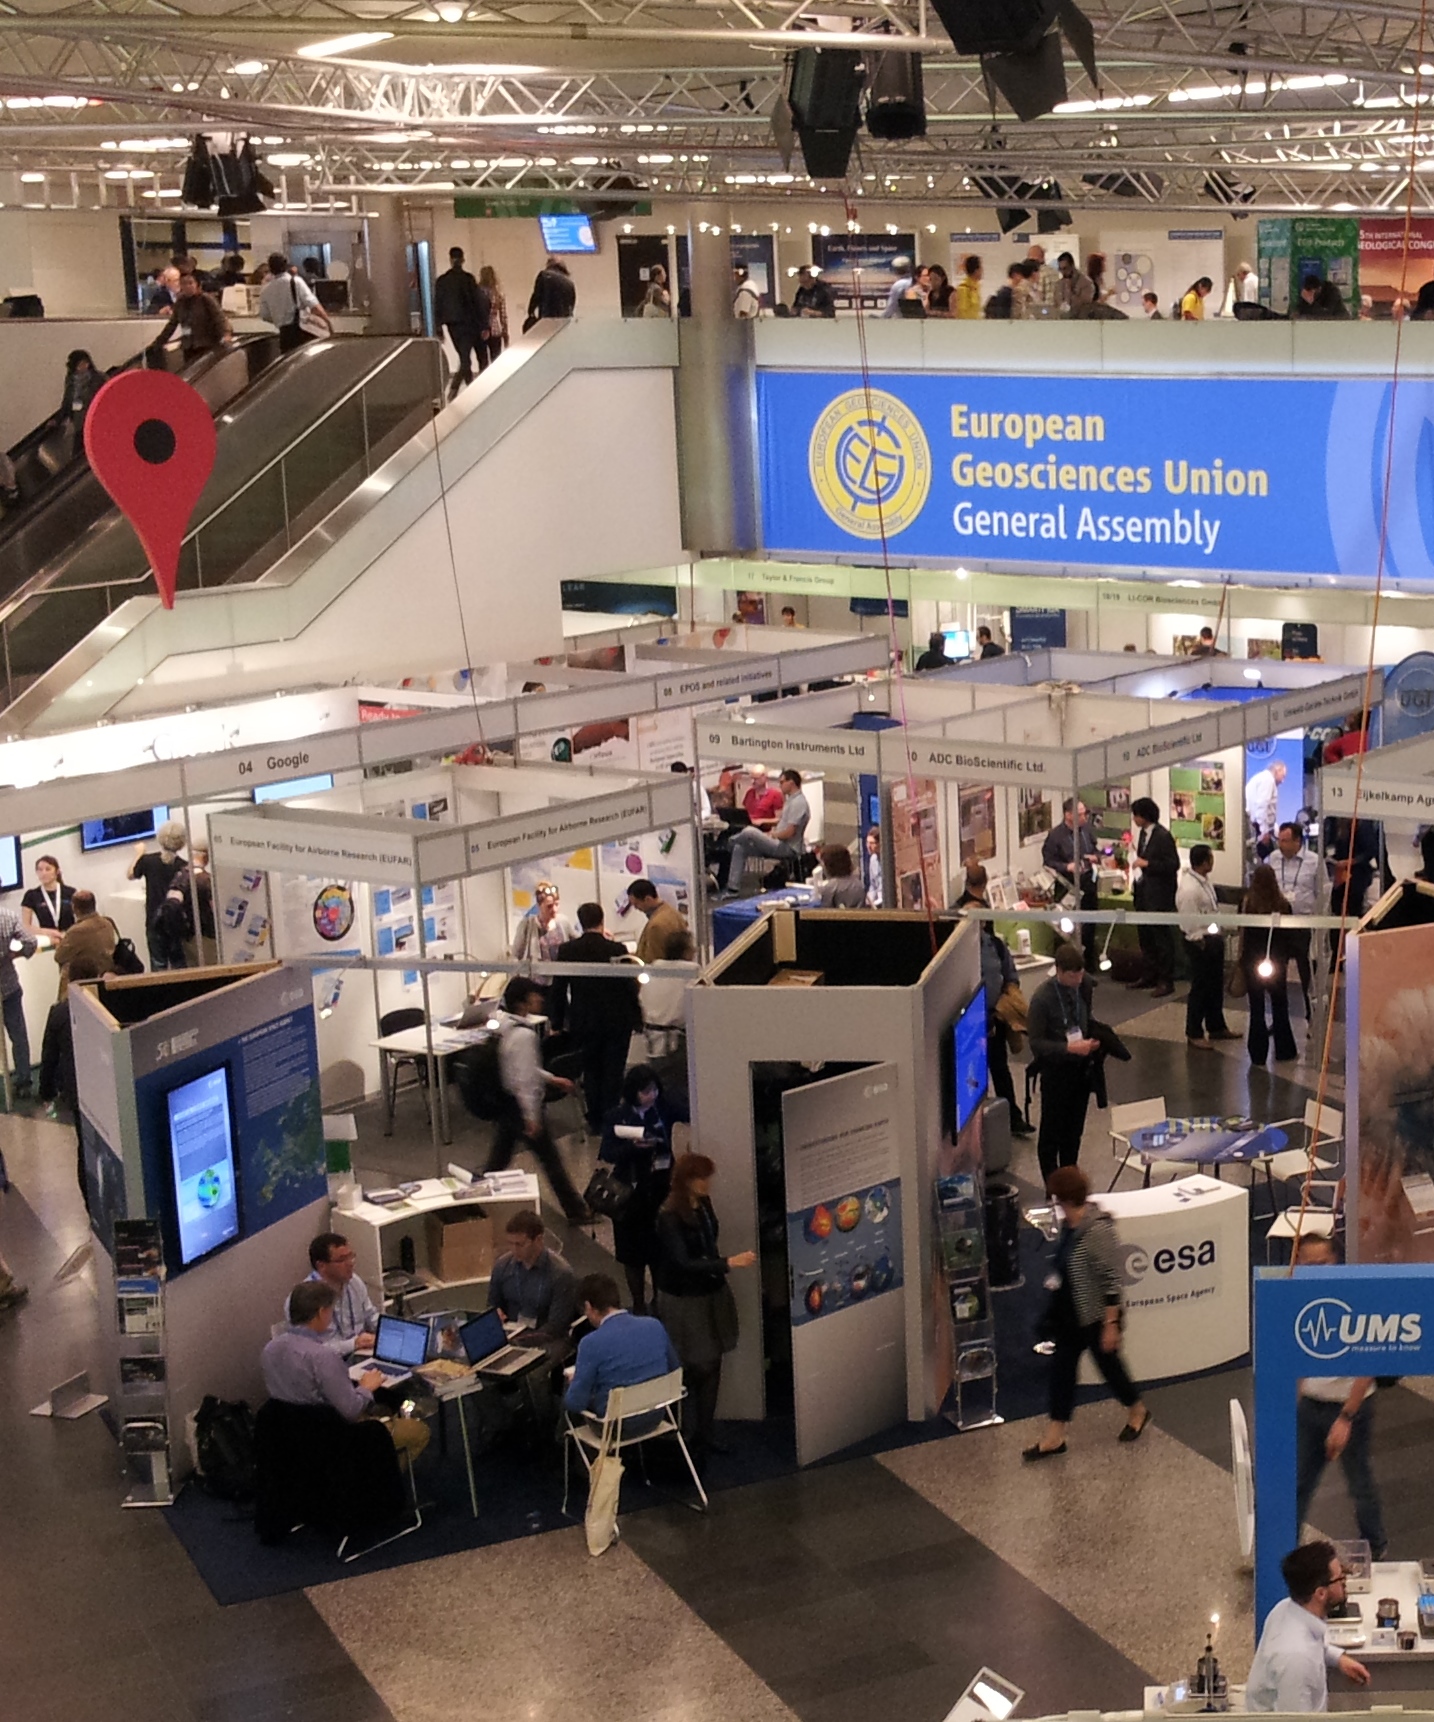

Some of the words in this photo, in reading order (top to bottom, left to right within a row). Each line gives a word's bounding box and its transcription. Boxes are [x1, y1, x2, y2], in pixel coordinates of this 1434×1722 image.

[1375, 231, 1423, 240] INTERNATONAL
[950, 404, 1105, 447] European
[816, 408, 843, 467] EUROPEAN
[910, 433, 925, 470] UNION
[951, 453, 1152, 494] Geosciences
[1163, 459, 1269, 497] Union
[952, 501, 1067, 541] General
[1076, 506, 1222, 555] Assembly
[789, 574, 813, 583] Francis
[814, 576, 834, 586] Group
[680, 681, 700, 694] EPOS
[702, 678, 715, 690] and
[716, 674, 740, 688] related
[709, 734, 720, 744] 09
[731, 735, 783, 750] Bartington
[786, 739, 846, 755] Instruments
[848, 745, 865, 756] Ltd
[1136, 744, 1151, 758] ADC
[238, 760, 254, 775] 04
[267, 751, 310, 771] Google
[929, 752, 953, 766] ADC
[955, 754, 1023, 772] BioScientific
[1026, 760, 1046, 773] Ltd.
[1331, 787, 1343, 798] 13
[487, 833, 521, 851] European
[522, 828, 547, 843] Facility
[548, 825, 558, 835] for
[559, 818, 588, 833] Airborne
[589, 811, 620, 826] Research
[230, 836, 265, 850] European
[266, 840, 294, 854] Facility
[295, 844, 305, 852] for
[307, 846, 340, 858] Airborne
[341, 849, 378, 862] Research
[379, 852, 413, 867] (EUFAR)
[1153, 1240, 1216, 1274] esa
[1125, 1296, 1165, 1308] European
[1167, 1292, 1189, 1304] Space
[1190, 1286, 1216, 1299] Agency
[1339, 1312, 1423, 1343] UMS
[1351, 1344, 1387, 1352] measure
[1398, 1343, 1422, 1352] know
